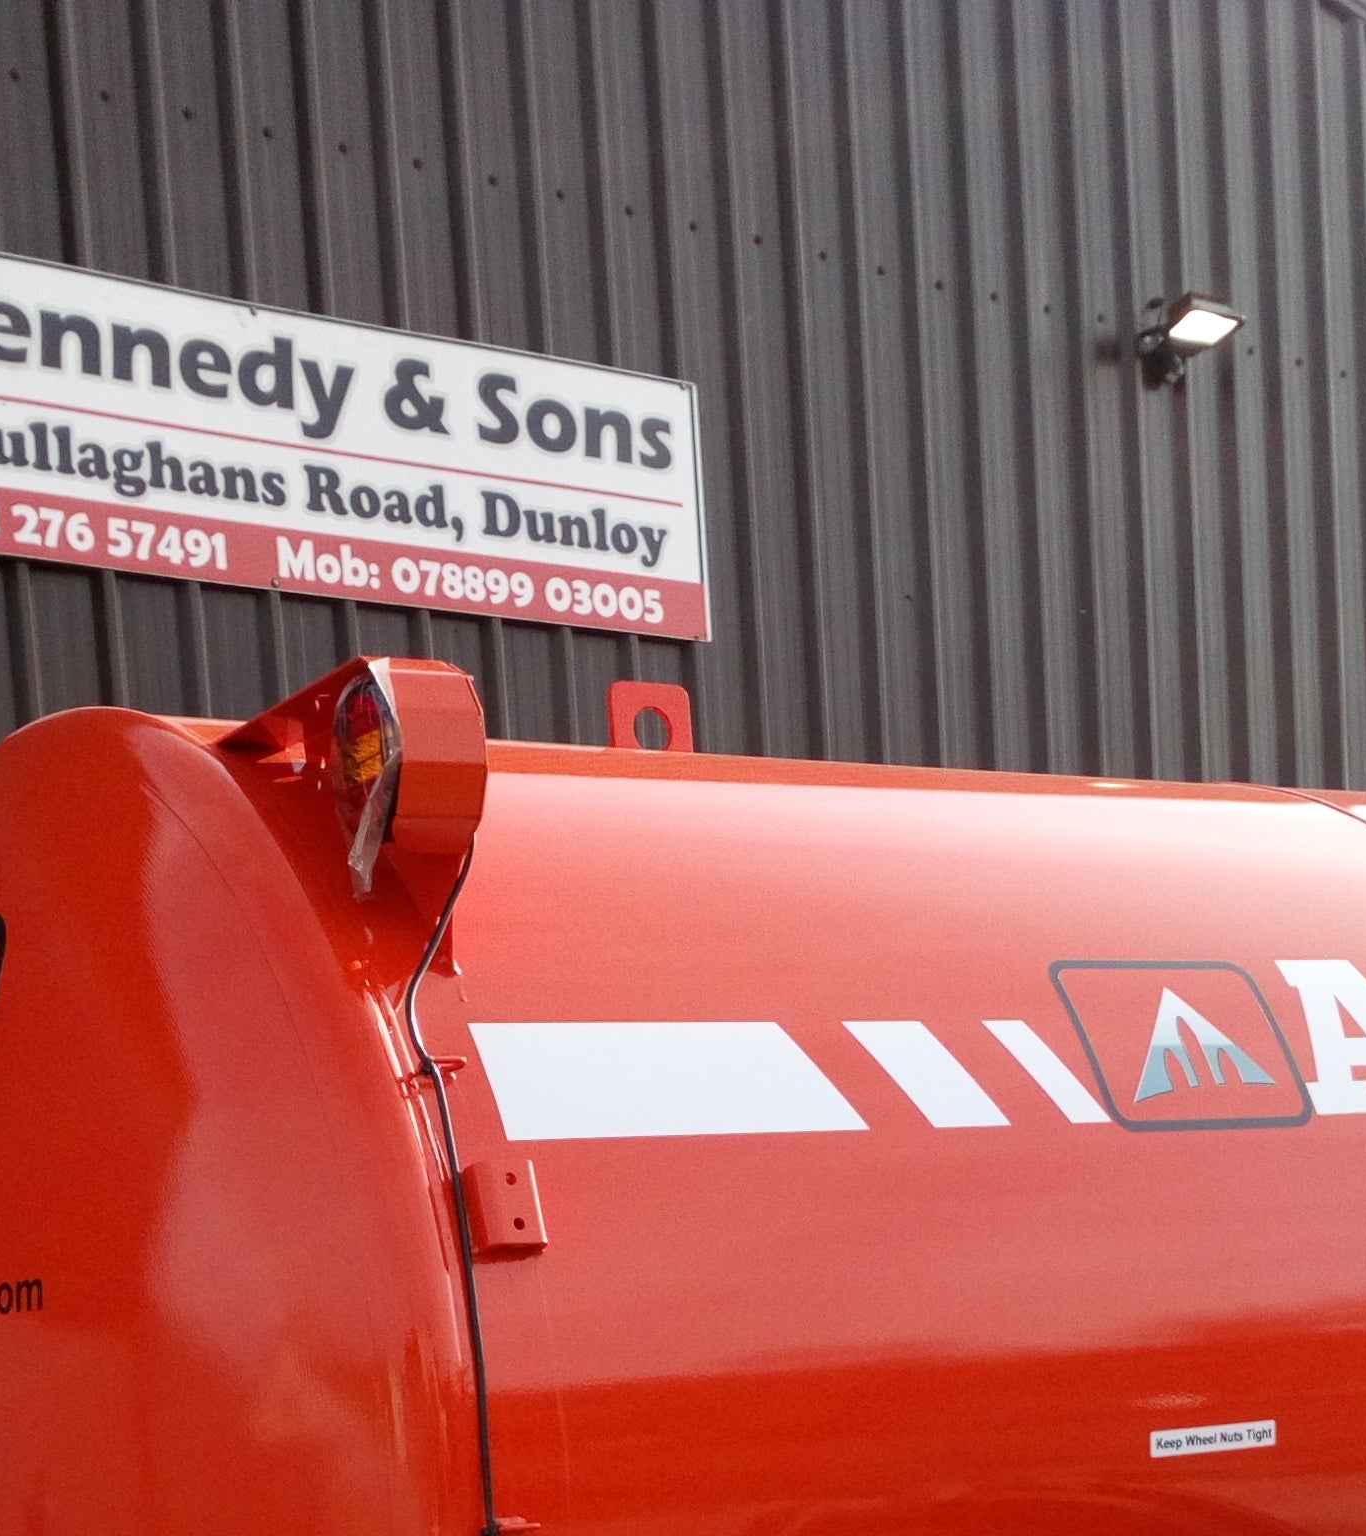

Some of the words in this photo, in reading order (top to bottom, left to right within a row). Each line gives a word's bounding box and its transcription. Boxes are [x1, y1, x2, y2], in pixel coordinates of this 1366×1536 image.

[382, 358, 450, 436] &
[477, 373, 672, 470] Sons
[11, 504, 91, 553] 276
[106, 516, 229, 571] 57491
[276, 535, 382, 591] Mob:
[391, 556, 535, 609] 078899
[544, 576, 665, 625] 03005
[303, 464, 464, 542] Road,
[482, 491, 667, 567] Dunloy
[1155, 1437, 1183, 1451] Keep
[1185, 1431, 1218, 1447] Wheel
[1220, 1430, 1244, 1444] Nuts
[1246, 1427, 1273, 1443] Tight
